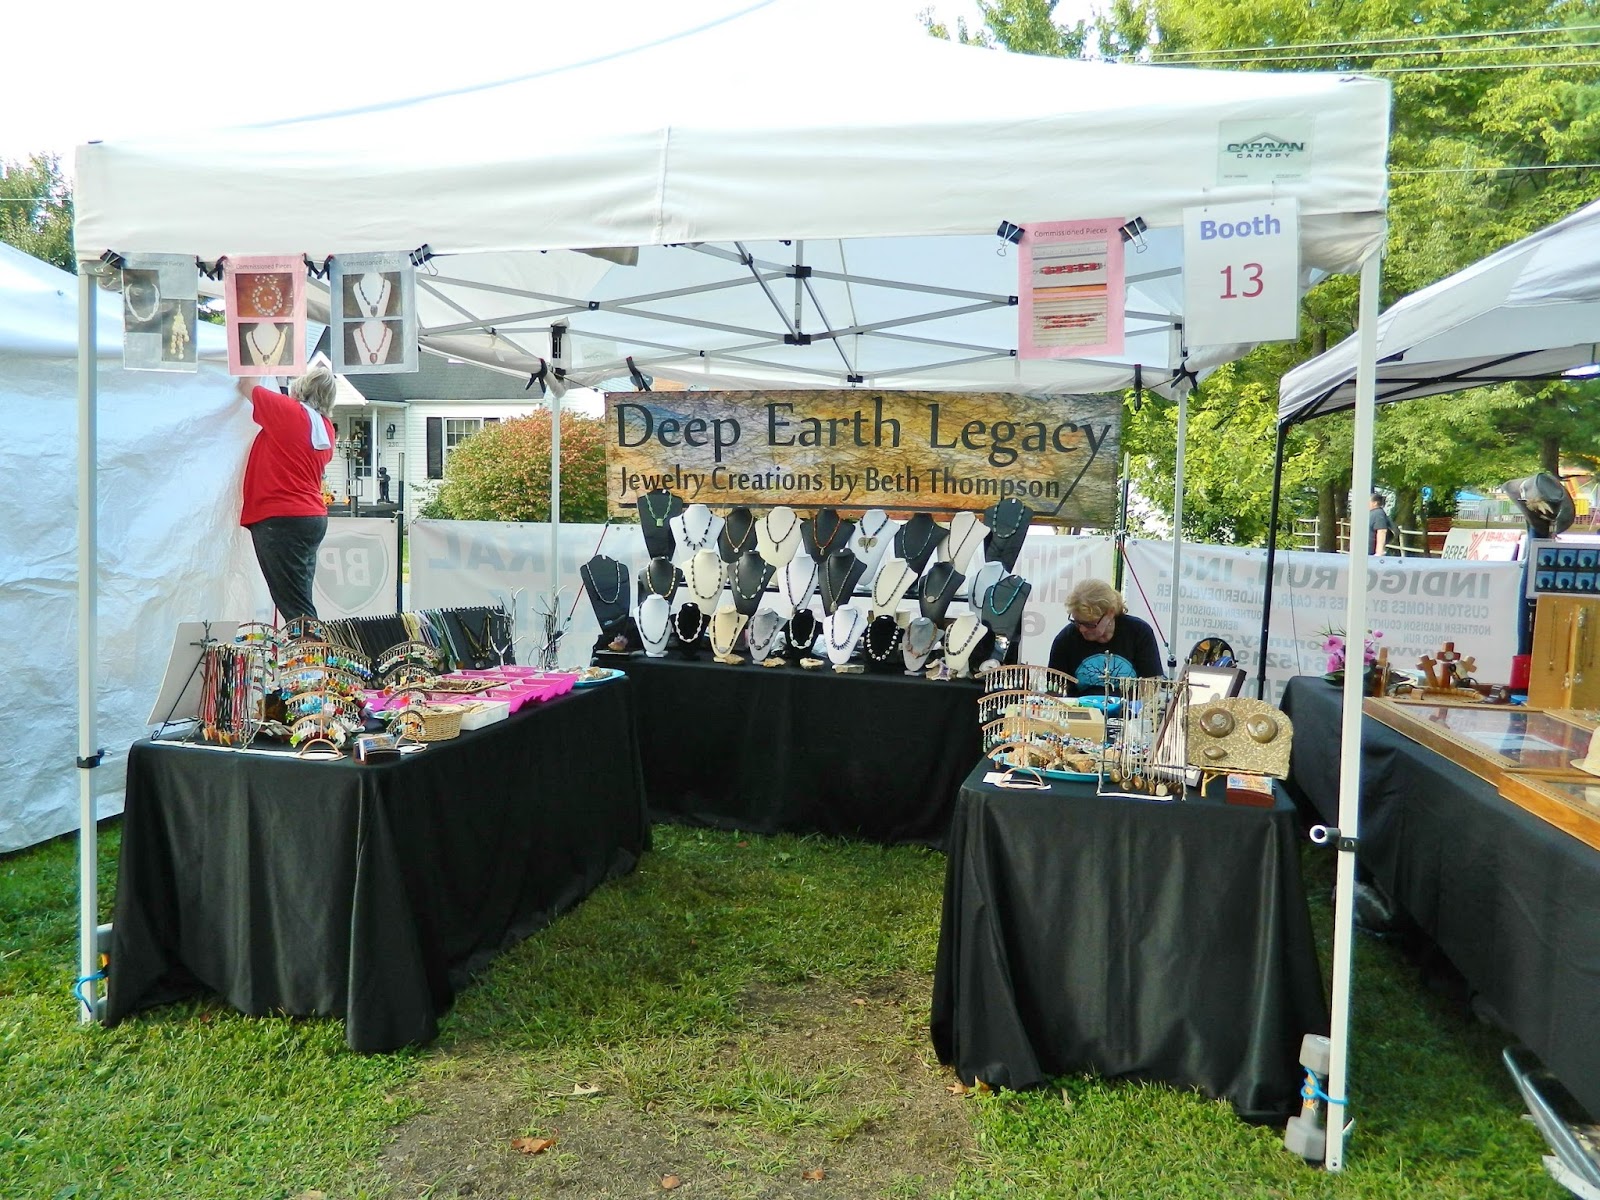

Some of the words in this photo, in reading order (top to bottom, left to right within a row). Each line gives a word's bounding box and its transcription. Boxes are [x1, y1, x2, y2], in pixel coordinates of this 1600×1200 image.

[1227, 142, 1304, 152] CARAVAN
[1034, 227, 1084, 237] Commissioned
[1086, 226, 1108, 235] Pieces
[1200, 214, 1281, 240] Booth
[343, 258, 383, 267] Commissioned
[1219, 263, 1265, 300] 13
[616, 404, 742, 463] Deep
[766, 398, 901, 449] Earth
[930, 403, 1112, 467] Legacy
[620, 466, 703, 495] Jewelry
[711, 467, 822, 492] Creations
[830, 467, 858, 497] by
[865, 467, 919, 494] Beth
[927, 468, 1061, 500] Thompson
[1444, 545, 1468, 560] BEREA
